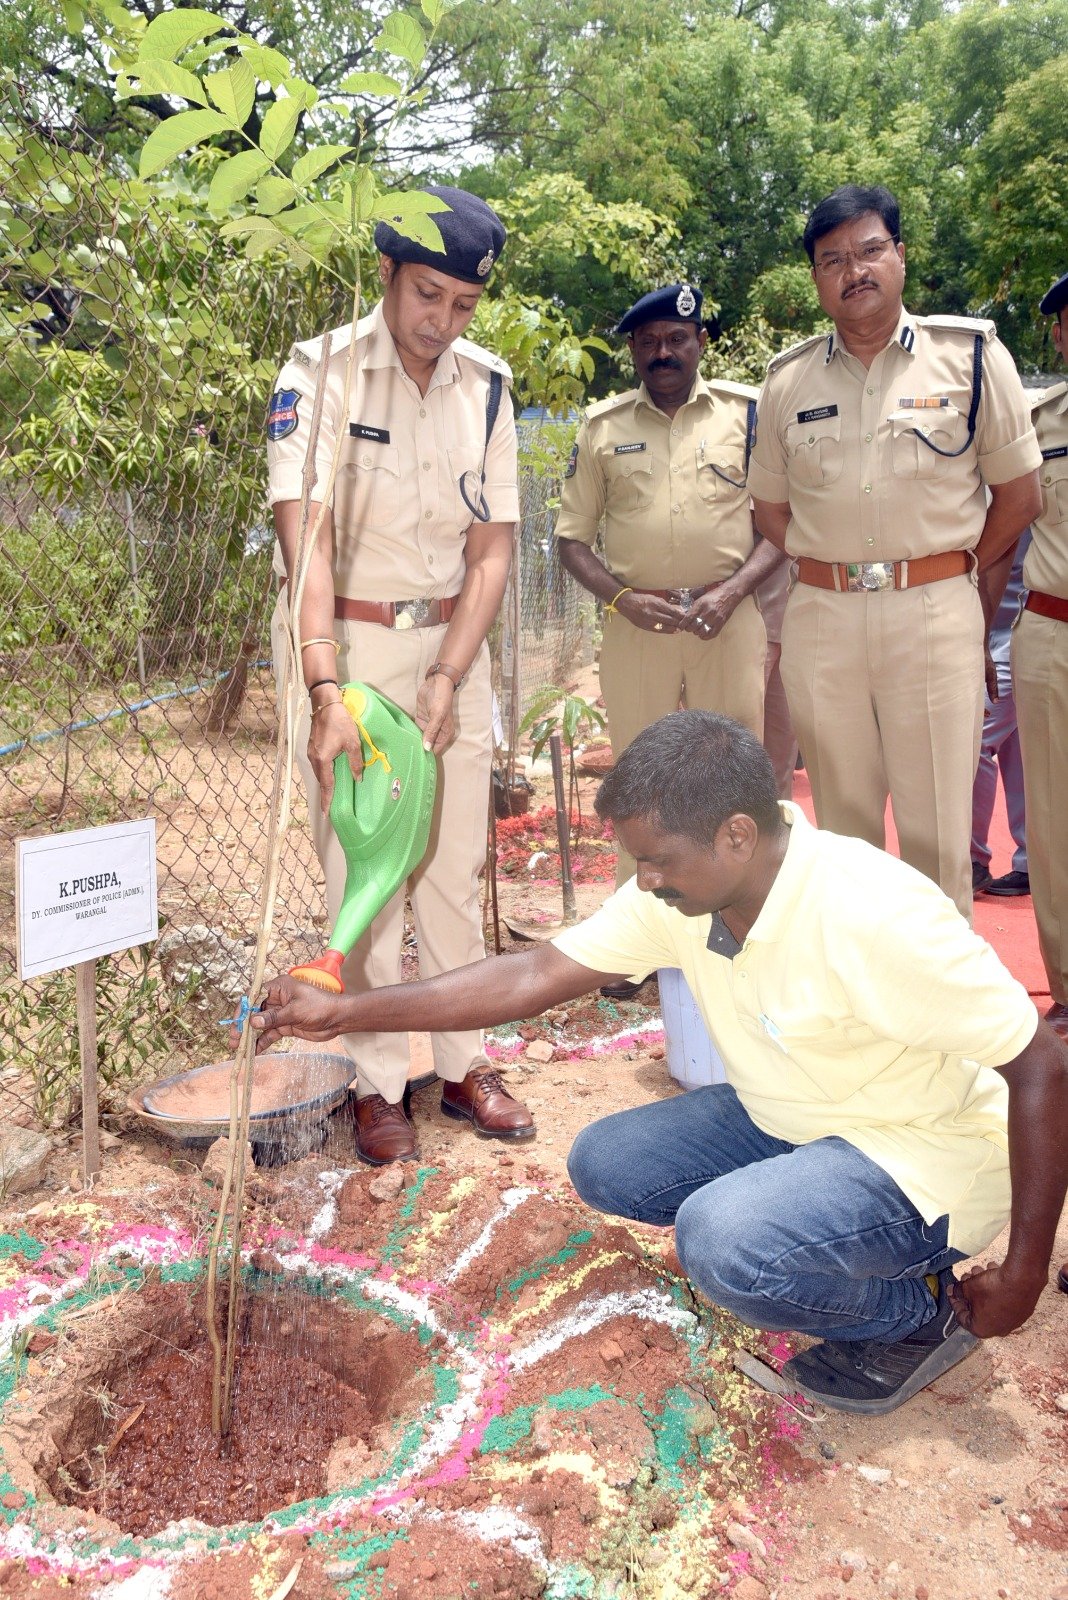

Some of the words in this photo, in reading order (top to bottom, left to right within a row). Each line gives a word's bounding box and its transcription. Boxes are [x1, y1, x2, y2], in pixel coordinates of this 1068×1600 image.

[59, 871, 122, 898] K.PUSHPA,
[31, 911, 42, 920] DY.
[43, 898, 91, 916] COMMISSIONER
[92, 896, 101, 905] OF
[101, 891, 122, 903] POLICE
[75, 906, 107, 920] WARANGAL
